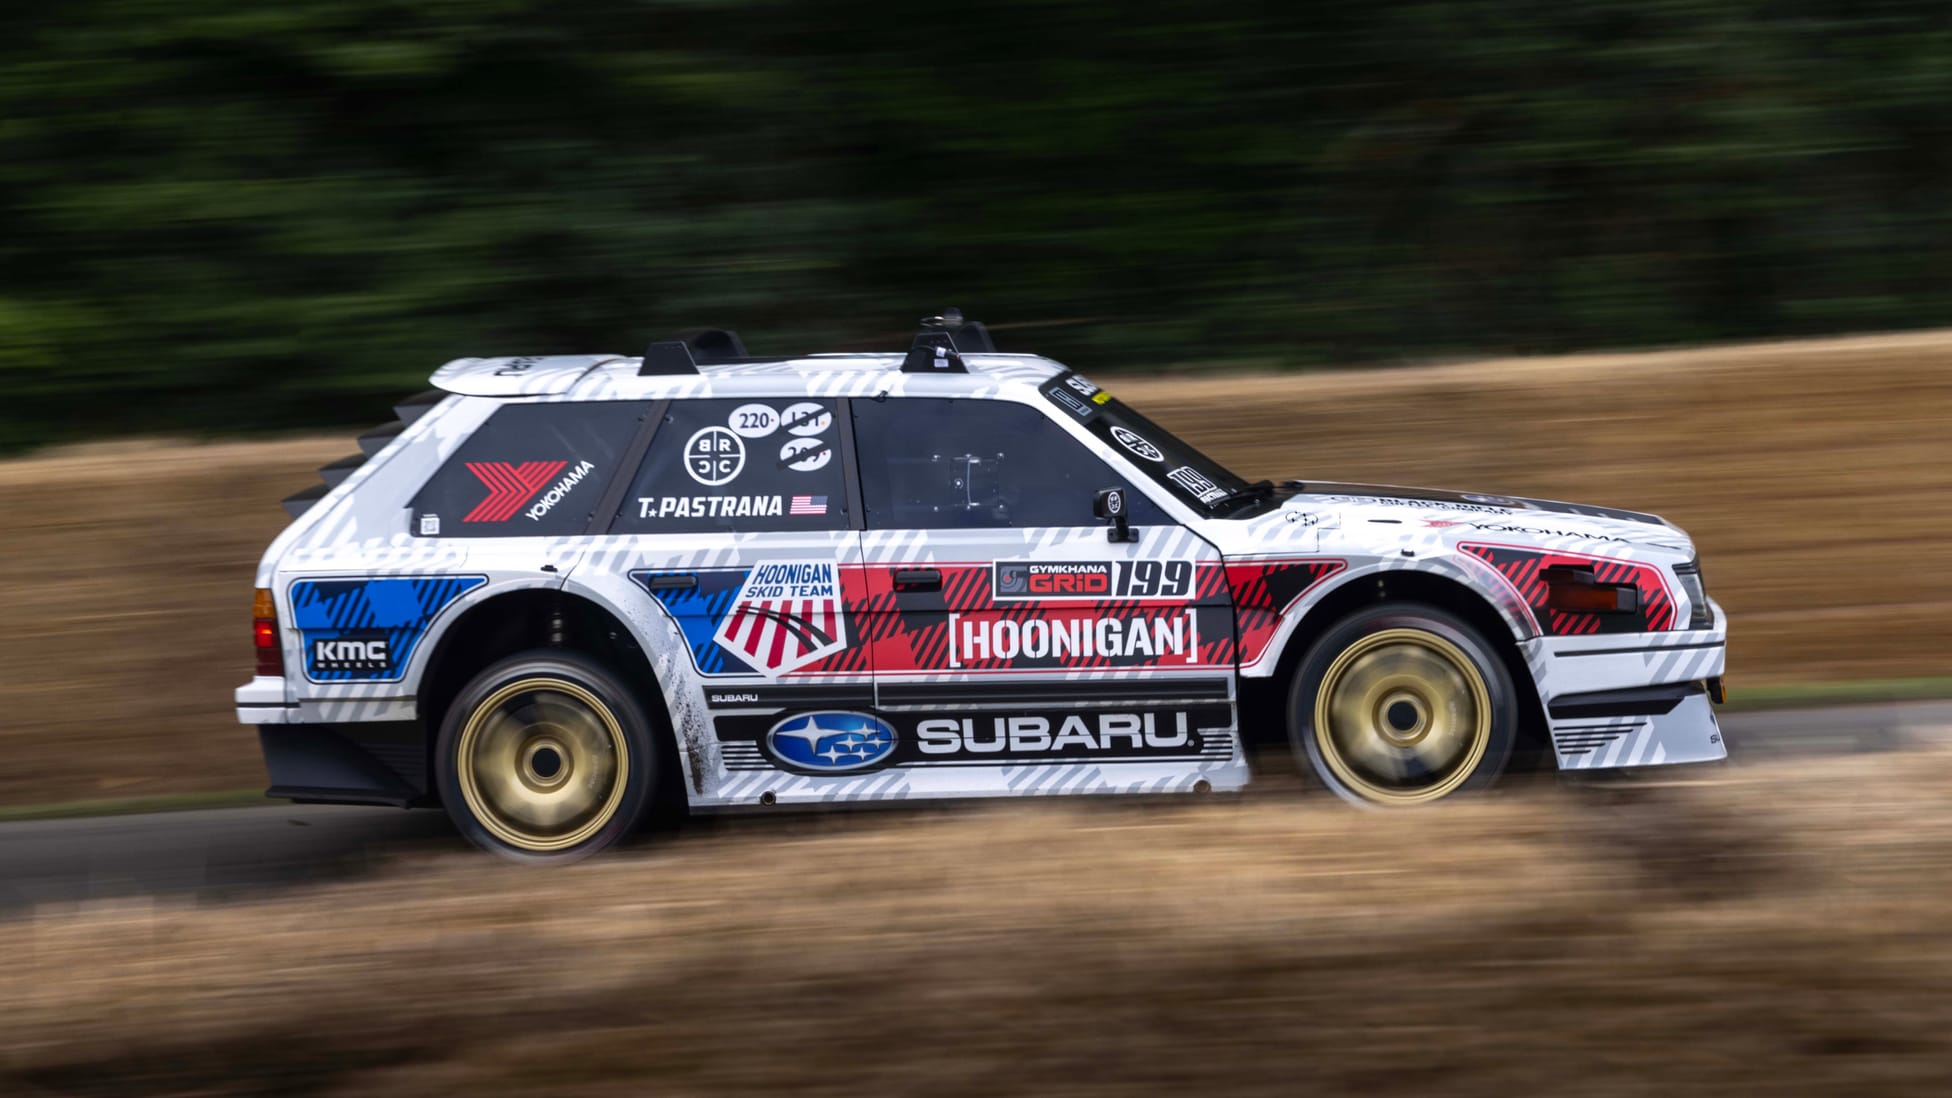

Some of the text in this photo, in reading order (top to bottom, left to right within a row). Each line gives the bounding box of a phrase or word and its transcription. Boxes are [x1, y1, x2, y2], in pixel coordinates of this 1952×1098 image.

[738, 412, 769, 429] 220
[525, 460, 595, 521] YOKOHAMA
[1469, 522, 1631, 544] YOKOHAMA
[752, 563, 832, 585] HOONIGAN
[1029, 564, 1108, 574] GYMKHANA
[1115, 560, 1193, 597] 199
[745, 585, 833, 598] SKID TEAM
[711, 694, 759, 703] SUBARU
[916, 712, 1188, 755] SUBARU
